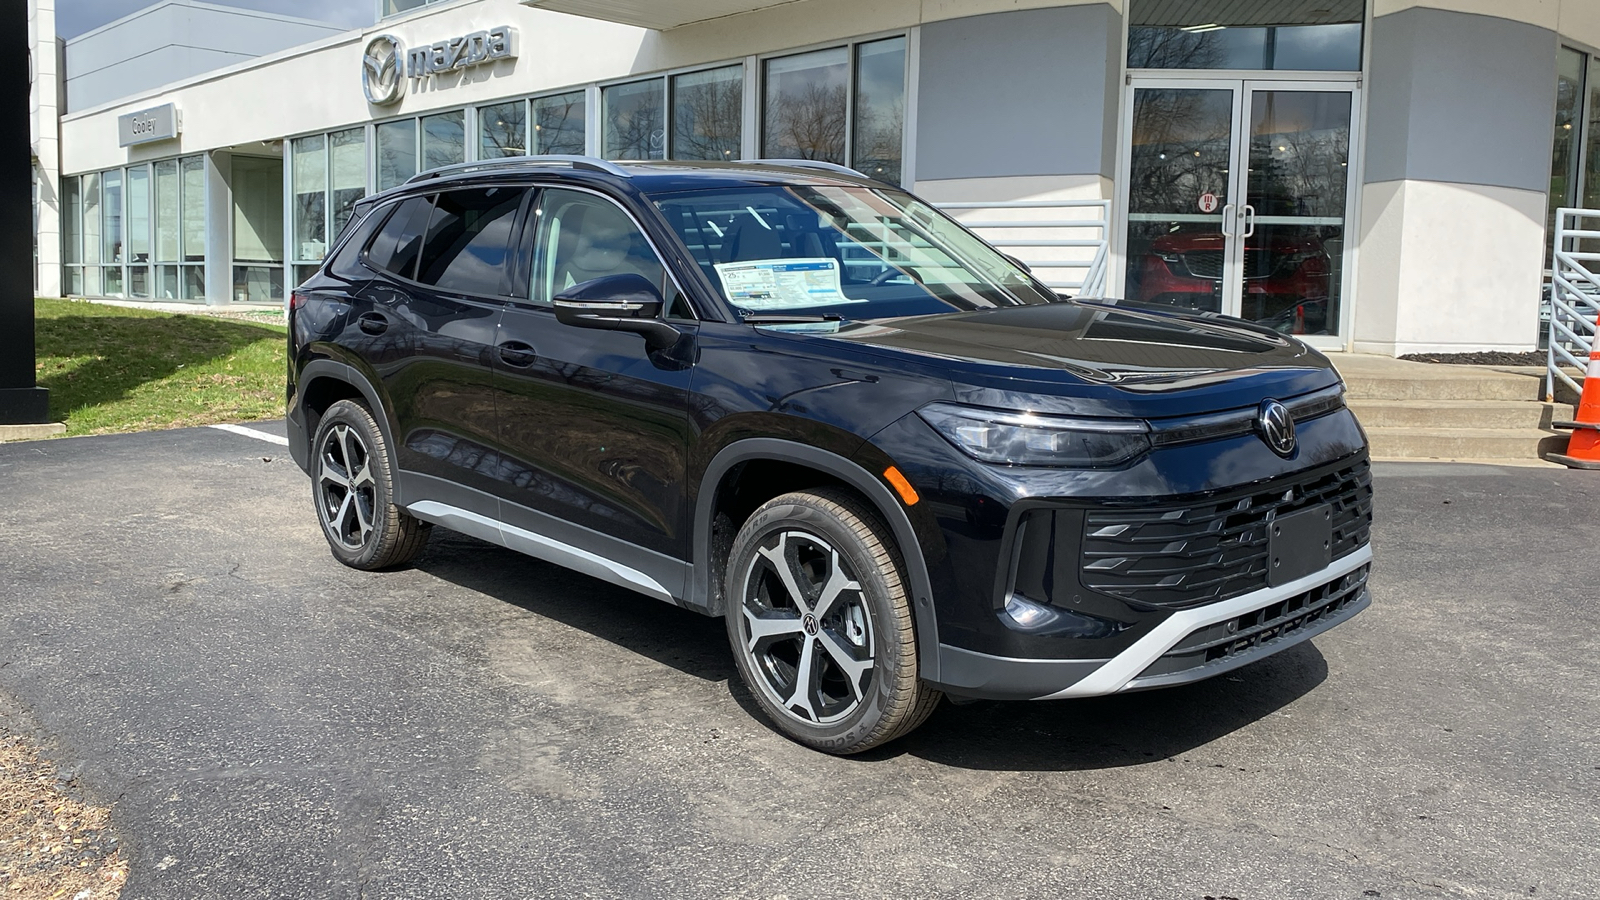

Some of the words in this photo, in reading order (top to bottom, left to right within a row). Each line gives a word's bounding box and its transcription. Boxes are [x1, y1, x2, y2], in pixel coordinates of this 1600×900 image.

[407, 25, 513, 78] mazda
[132, 112, 156, 136] Cooley
[1205, 203, 1212, 211] R
